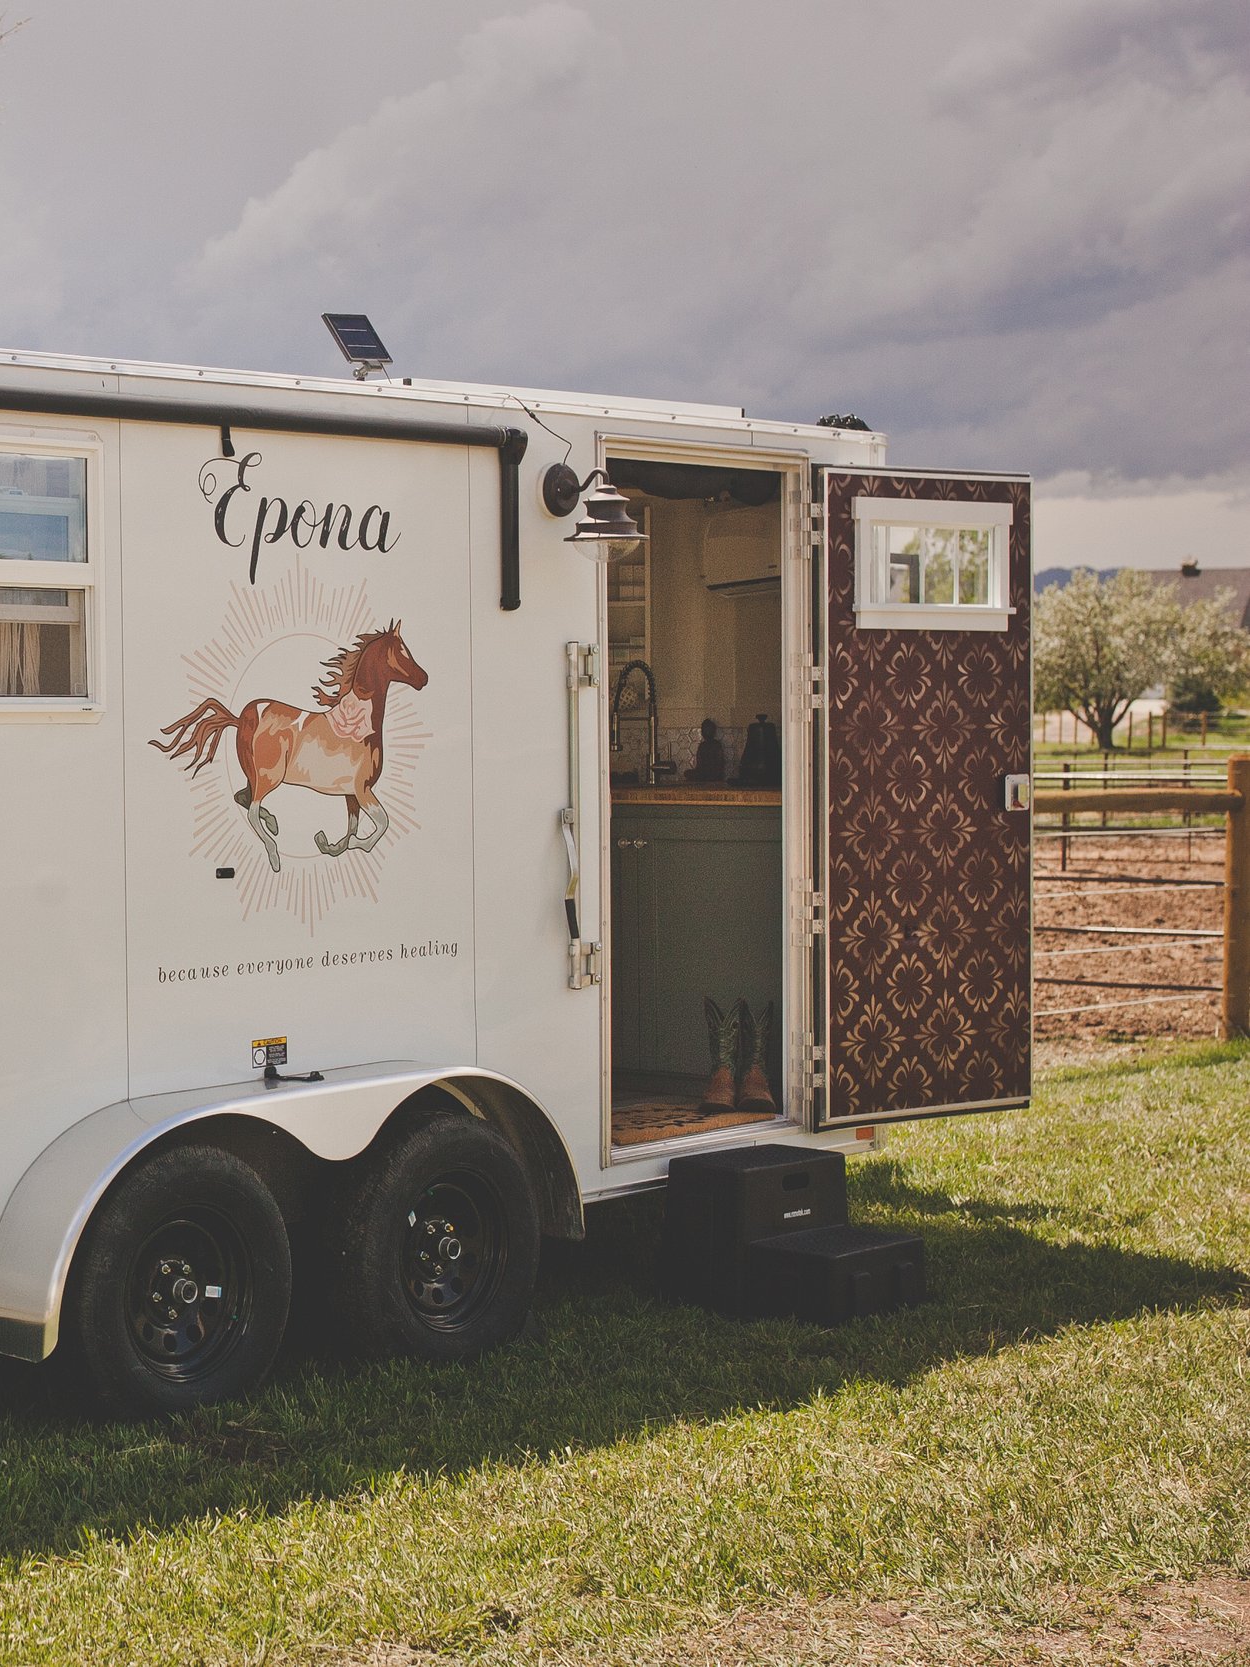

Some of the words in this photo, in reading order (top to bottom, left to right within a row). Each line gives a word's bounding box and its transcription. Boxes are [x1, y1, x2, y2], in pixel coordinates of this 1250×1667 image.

[198, 452, 402, 585] Epona
[158, 964, 229, 984] because
[237, 956, 314, 976] everyone
[321, 948, 393, 968] deserves
[400, 940, 458, 959] healing
